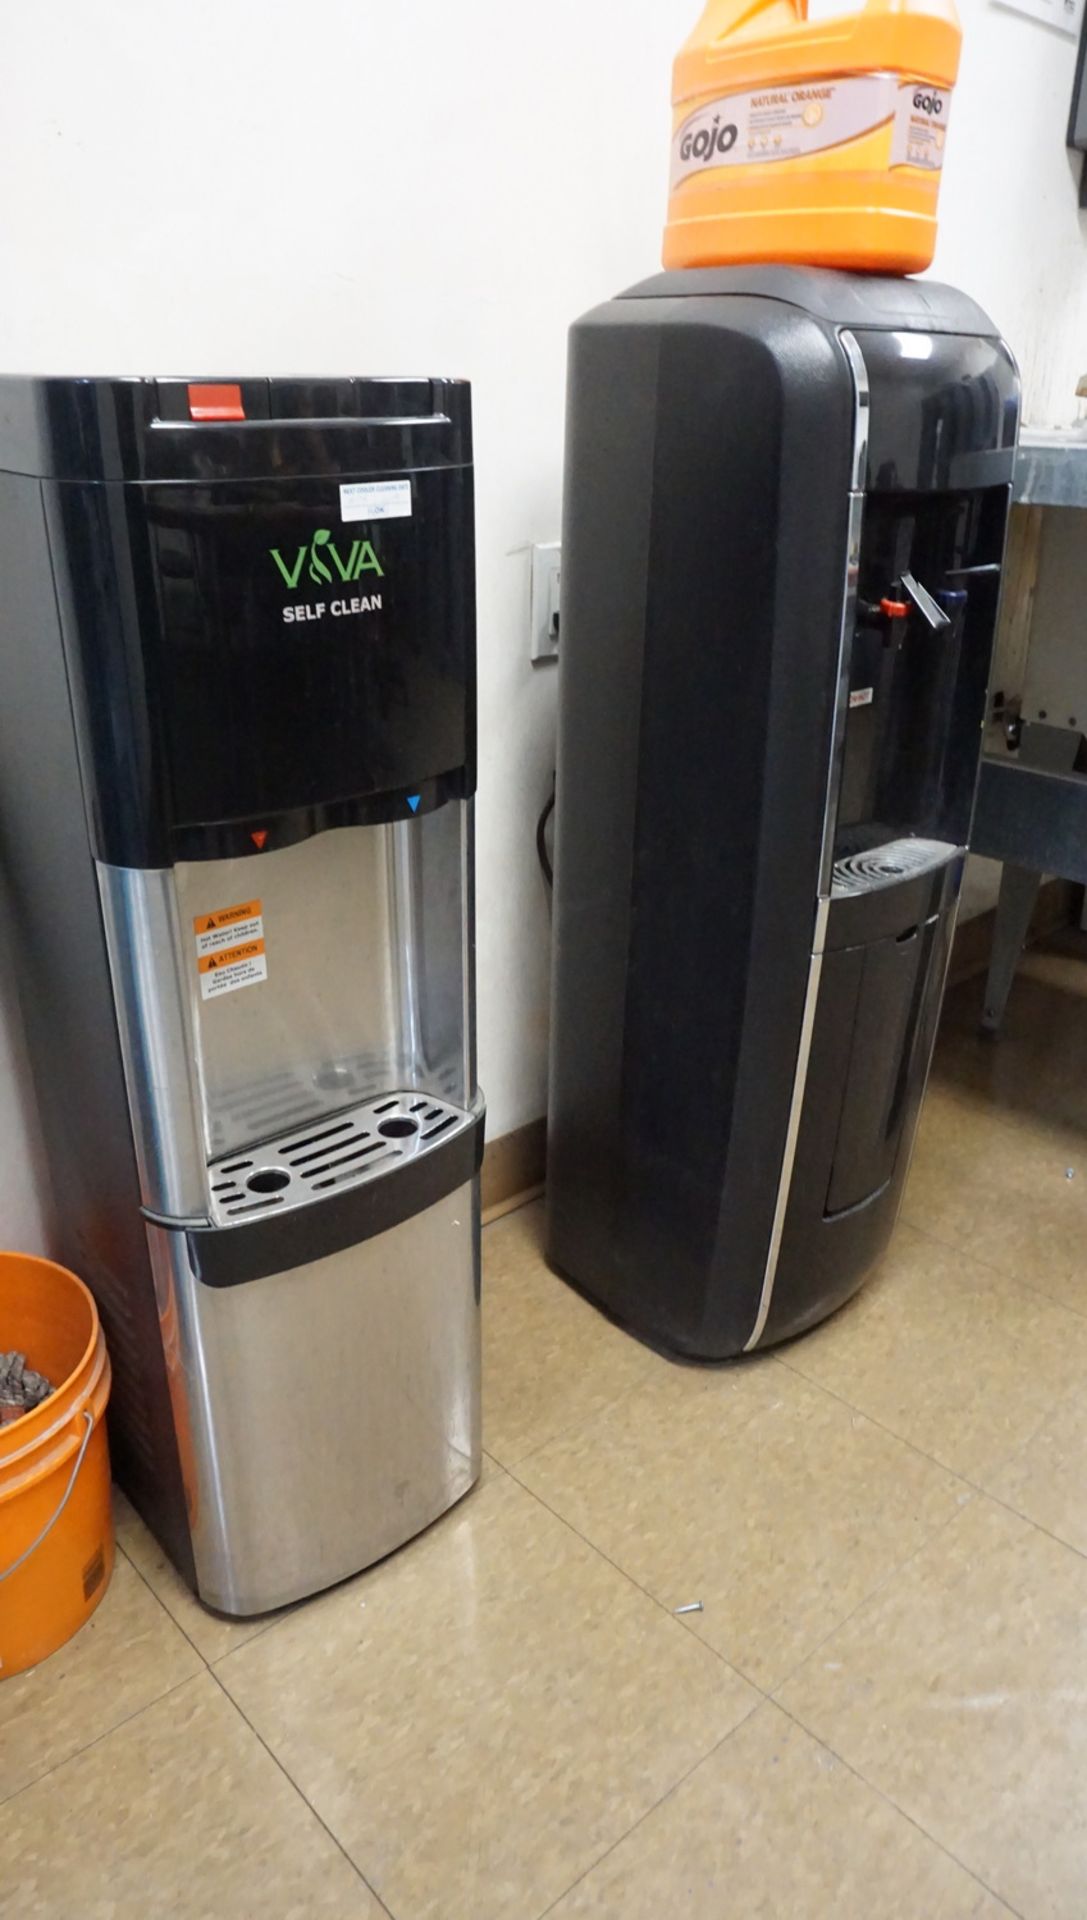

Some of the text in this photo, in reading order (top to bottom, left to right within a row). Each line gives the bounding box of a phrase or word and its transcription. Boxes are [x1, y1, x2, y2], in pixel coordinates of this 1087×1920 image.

[268, 528, 385, 590] VIVA
[282, 594, 383, 623] SELF CLEAN
[217, 906, 252, 923] WARNING
[218, 944, 258, 962] ATTENTION
